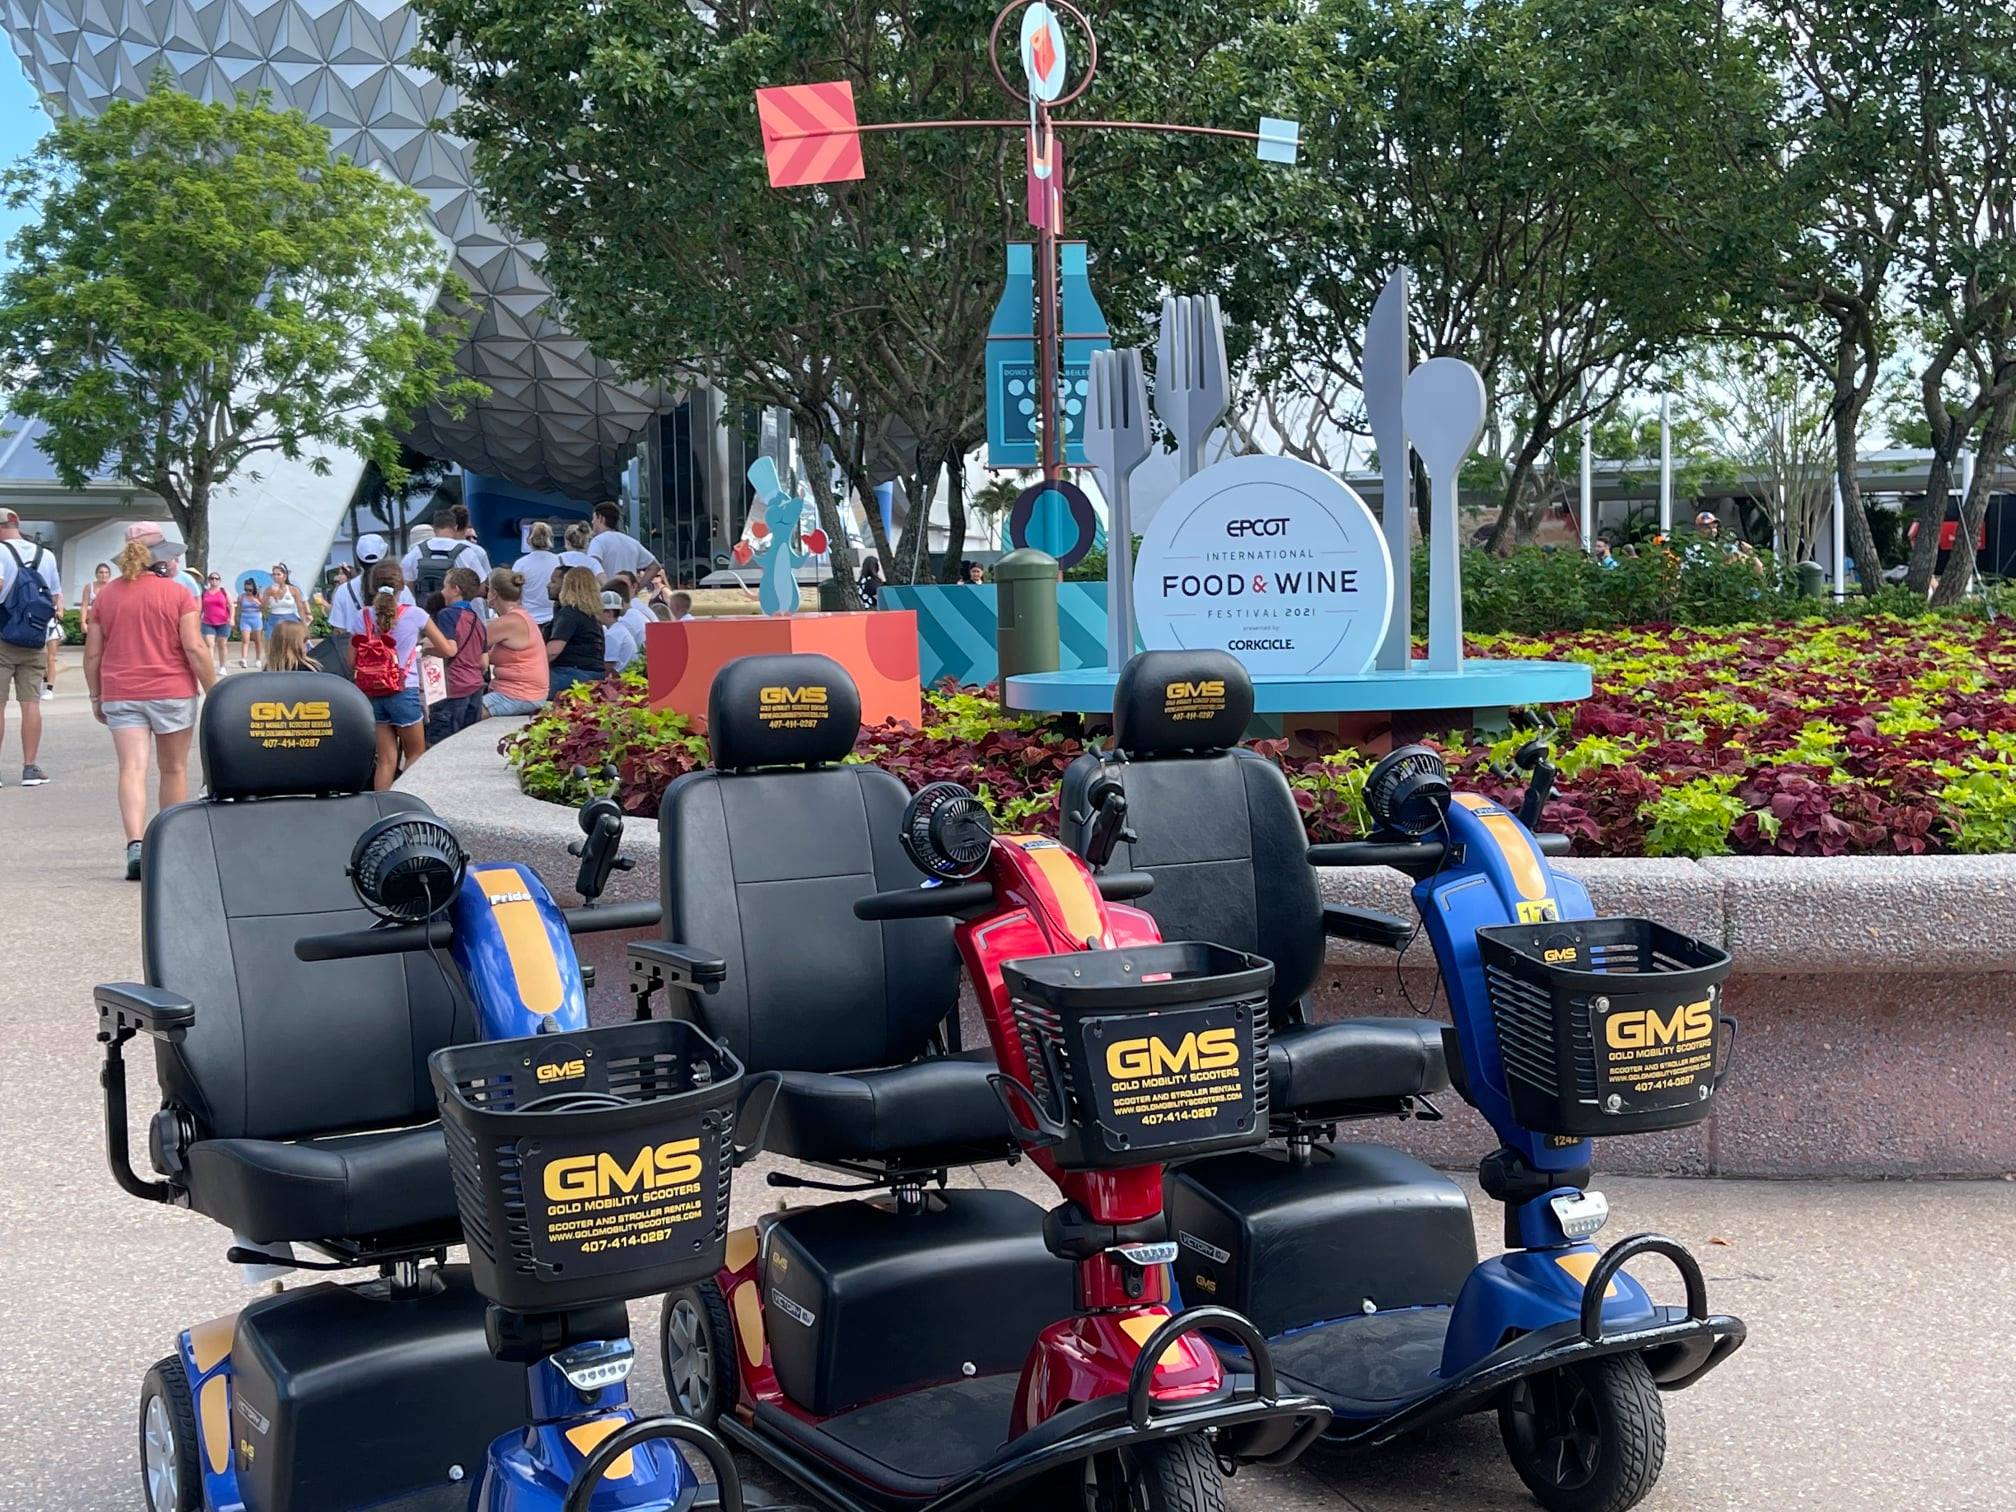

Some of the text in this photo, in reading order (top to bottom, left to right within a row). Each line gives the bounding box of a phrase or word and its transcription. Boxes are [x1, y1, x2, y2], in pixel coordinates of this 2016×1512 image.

[1226, 518, 1290, 537] EPCOT
[1206, 549, 1314, 561] INTERNATIONAL
[1163, 570, 1358, 597] FOOD & WINE
[1207, 608, 1316, 618] FESTIVAL 2021
[1228, 639, 1295, 650] CORKCICLE.
[760, 686, 828, 704] GMS
[1166, 681, 1225, 699] GMS
[250, 701, 331, 720] GMS
[262, 738, 320, 748] 407-414-0287
[490, 891, 531, 904] Pride
[1544, 947, 1577, 961] GMS
[1605, 1000, 1713, 1049] GMS
[1106, 1028, 1239, 1079] GMS
[1608, 1038, 1712, 1061] GOLD MOBILITY SCOOTERS
[536, 1059, 586, 1080] GMS
[1609, 1064, 1643, 1075] SCOOTER
[1644, 1063, 1659, 1071] AND
[1660, 1058, 1689, 1069] STROLLER
[1111, 1068, 1240, 1092] GOLD MOBILITY SCOOTERS
[1634, 1074, 1695, 1092] 407-414-0287
[1113, 1083, 1242, 1106] SCOOTER AND STROLLER RENTALS
[1114, 1092, 1243, 1116] WWW.GOLDMOBILITYSCOOTERS.COM
[1141, 1107, 1218, 1125] 407-414-0287
[543, 1138, 702, 1201] GMS
[547, 1182, 701, 1216] GOLD MOBILITY SCOOTERS
[548, 1200, 702, 1232] SCOOTER AND STROLLER RENTALS
[548, 1210, 703, 1242] WWW.GOLDMOBILITYSCOOTERS.COM
[581, 1228, 672, 1253] 407-414-0287
[1196, 1275, 1217, 1292] GMS
